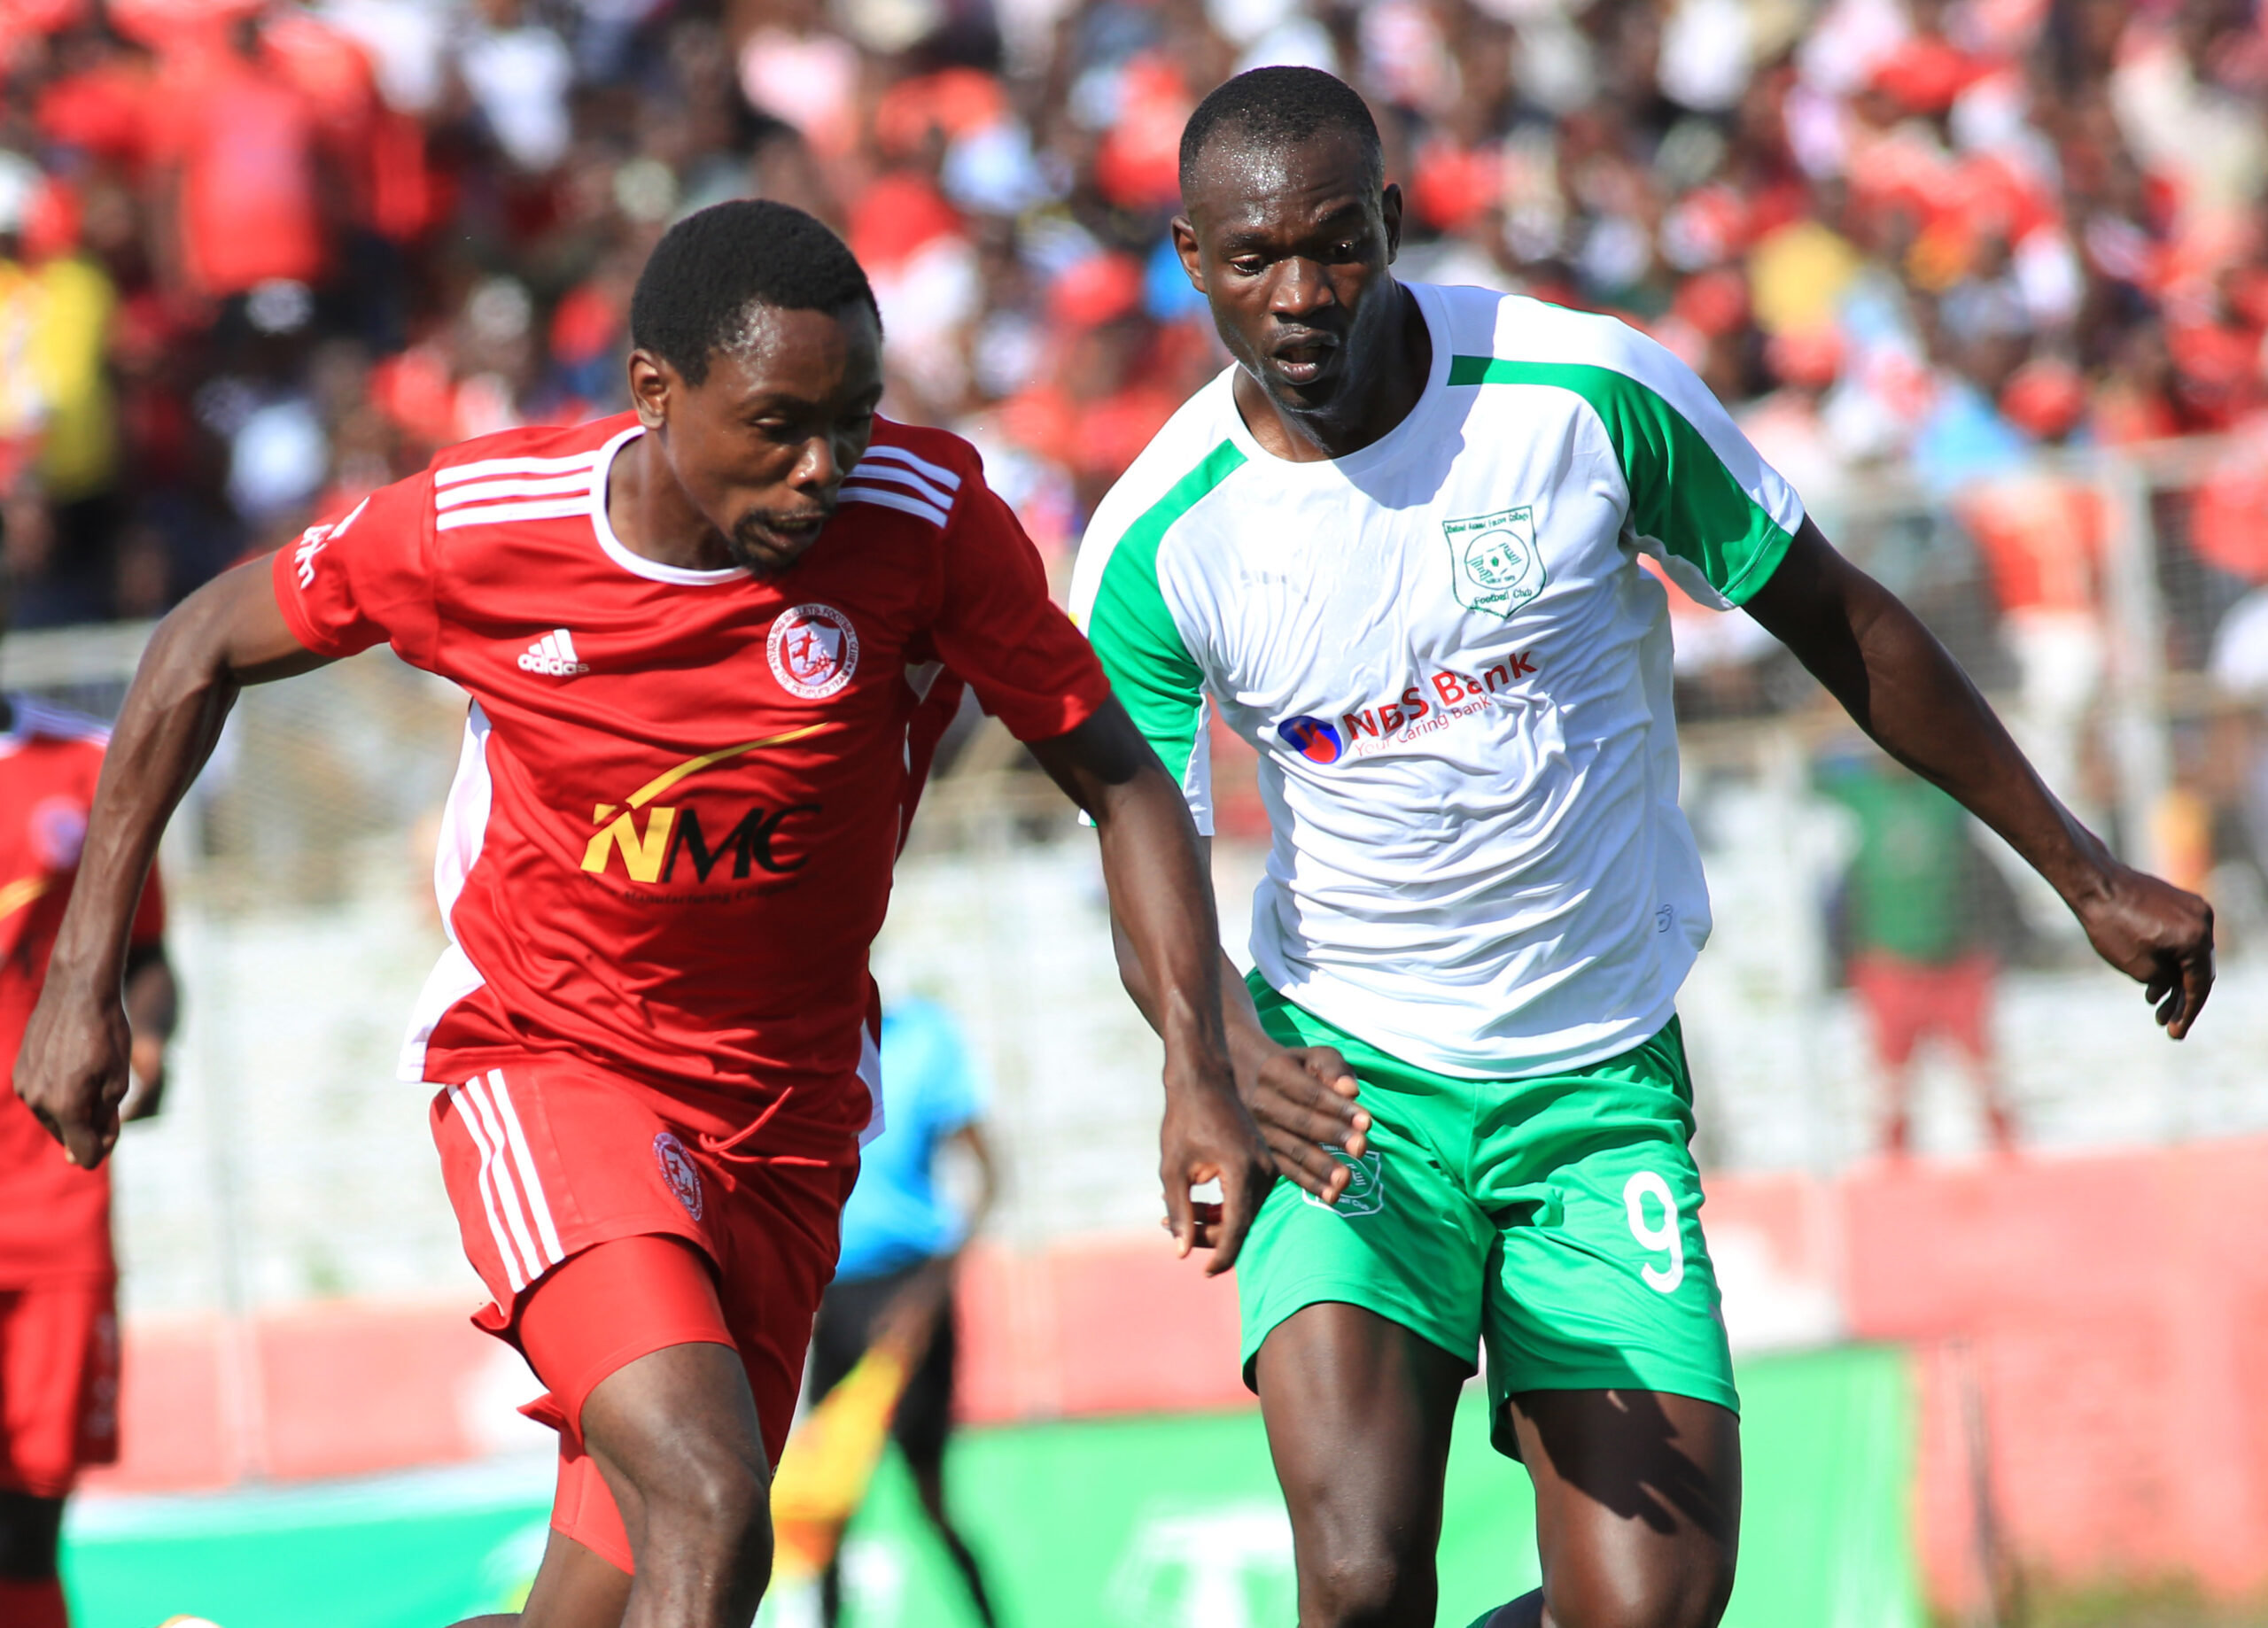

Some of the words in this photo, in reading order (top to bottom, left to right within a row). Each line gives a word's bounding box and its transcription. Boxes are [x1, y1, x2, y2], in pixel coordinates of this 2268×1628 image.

[1513, 587, 1533, 599] Club
[517, 653, 590, 677] adidas
[1343, 687, 1429, 740] NBS
[1431, 651, 1538, 708] Bank
[1355, 739, 1391, 757] Your
[1396, 713, 1449, 744] Caring
[1450, 694, 1493, 720] Bank
[580, 803, 823, 884] NMC
[1623, 1171, 1684, 1294] 9
